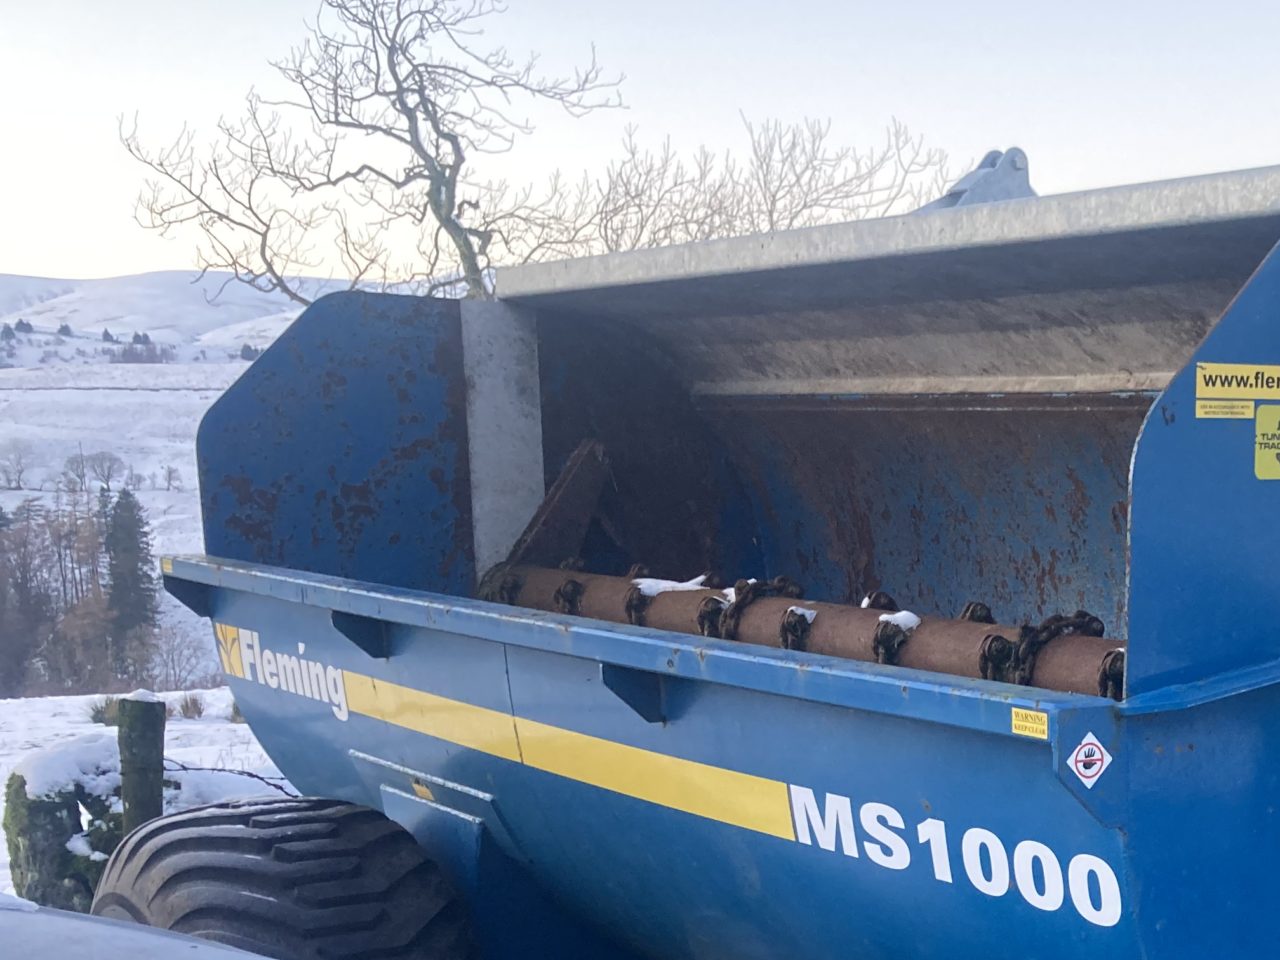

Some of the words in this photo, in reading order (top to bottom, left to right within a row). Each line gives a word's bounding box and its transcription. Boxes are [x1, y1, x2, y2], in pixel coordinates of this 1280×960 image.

[238, 628, 349, 722] Fleming
[1014, 711, 1045, 726] WARNING
[1014, 723, 1028, 731] KEEP
[789, 783, 1122, 927] MS1000
